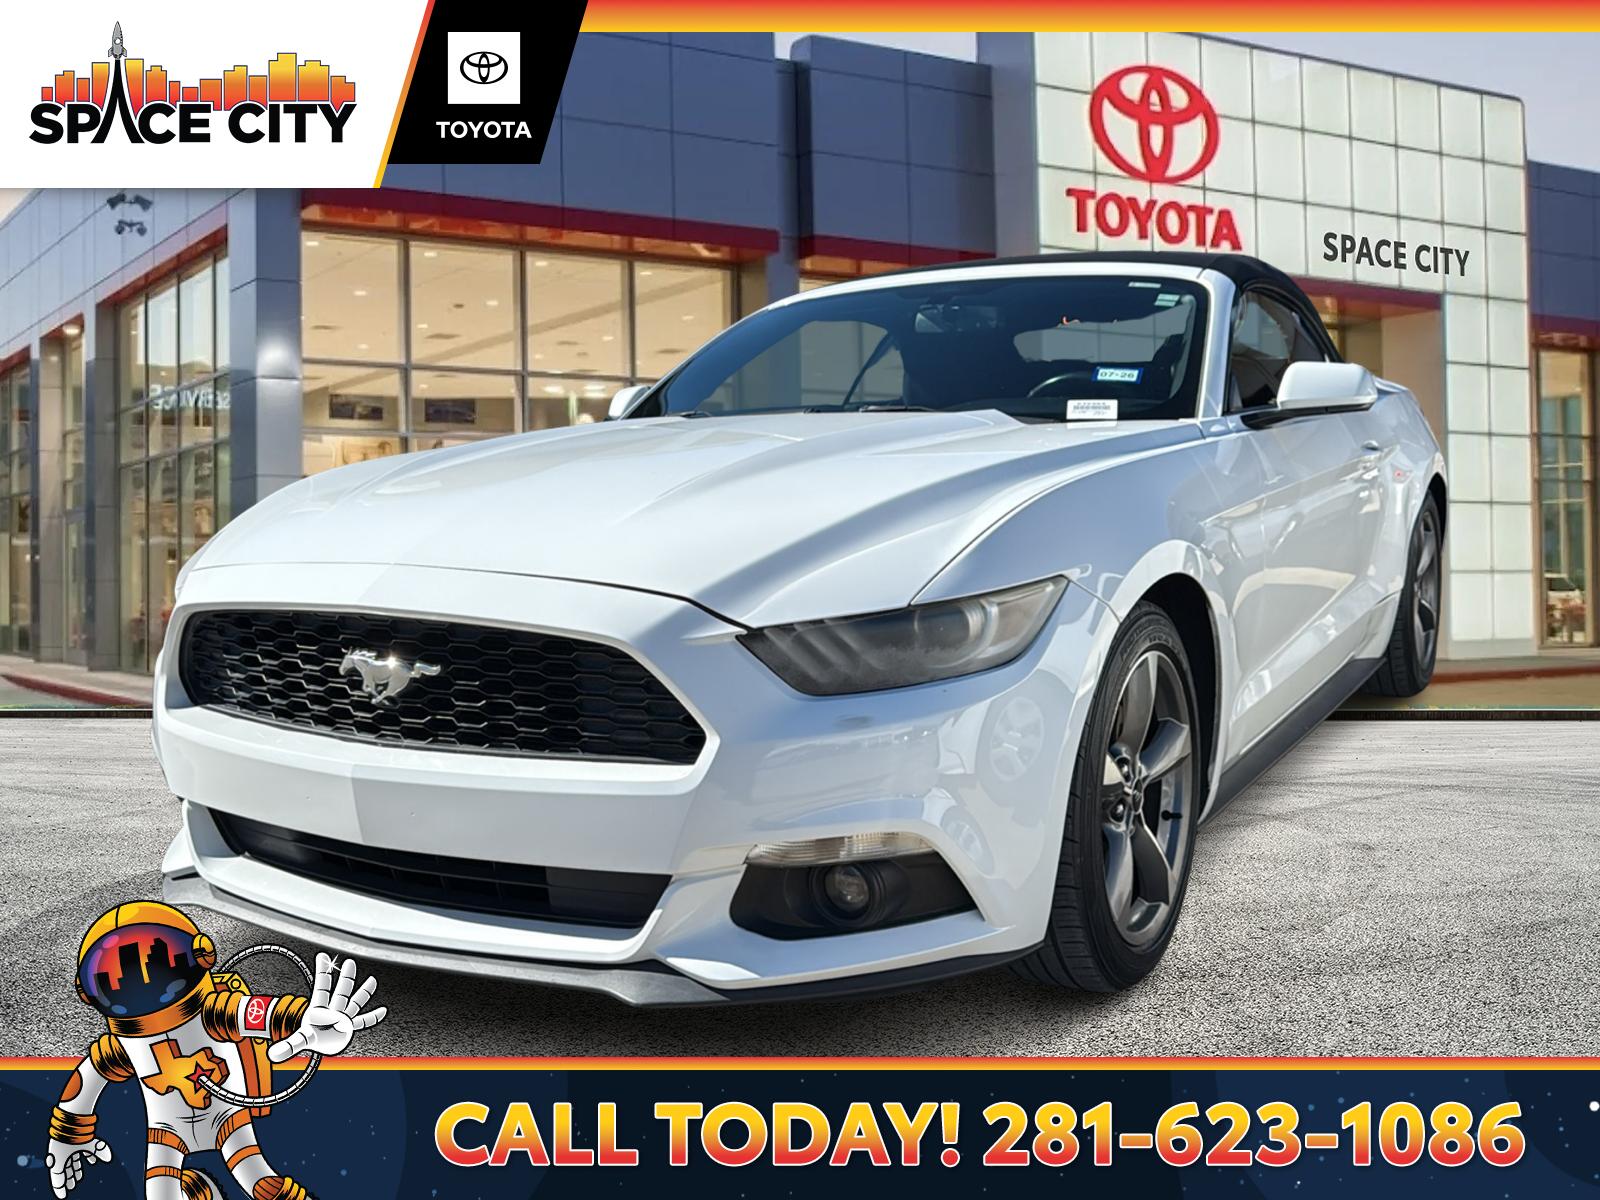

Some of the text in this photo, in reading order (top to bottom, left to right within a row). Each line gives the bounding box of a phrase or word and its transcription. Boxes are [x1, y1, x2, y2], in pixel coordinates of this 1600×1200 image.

[1067, 188, 1242, 250] TOYOTA
[1323, 232, 1470, 277] SPACE CITY
